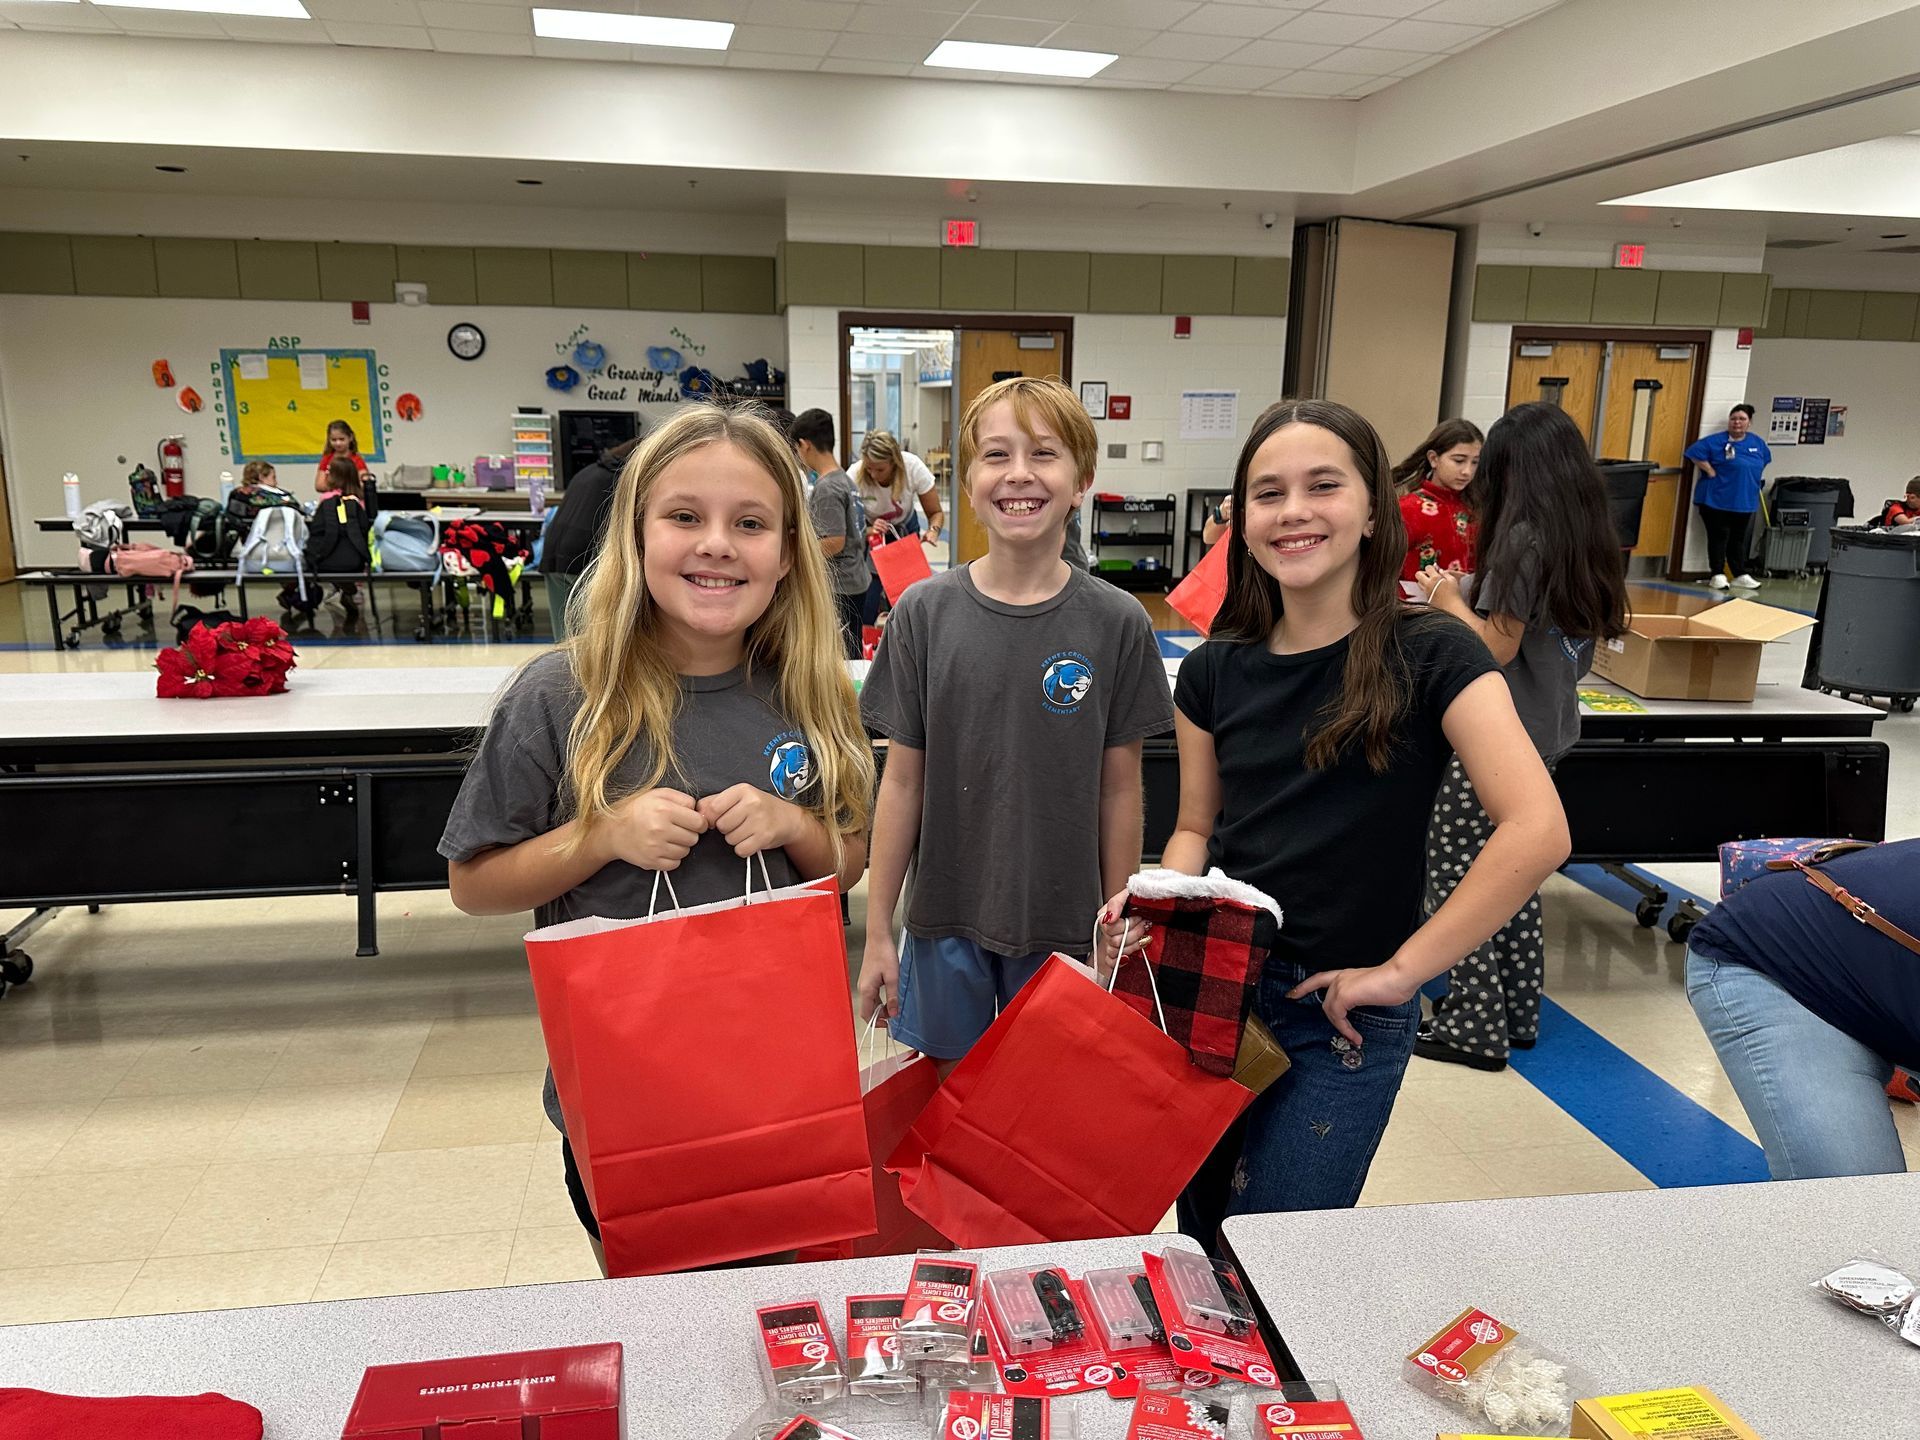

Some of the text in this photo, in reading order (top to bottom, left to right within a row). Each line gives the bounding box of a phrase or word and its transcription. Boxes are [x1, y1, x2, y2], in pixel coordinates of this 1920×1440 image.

[947, 220, 975, 246] EXIT
[1620, 245, 1645, 267] EXIT
[268, 336, 301, 349] ASP
[330, 355, 341, 368] 2
[607, 364, 663, 388] Growing
[587, 384, 679, 403] Great Minds
[210, 363, 229, 456] Parents
[240, 401, 249, 415] 3
[287, 399, 297, 412] 4
[350, 399, 360, 412] 5
[378, 364, 392, 447] Corner
[1067, 651, 1096, 673] CROSSING
[1041, 701, 1081, 715] ELEMENTARY
[763, 732, 787, 757] KEENE'S
[954, 1285, 968, 1299] 10
[807, 1323, 824, 1336] 10
[420, 1375, 556, 1396] MINI STRING LIGHTS
[991, 1403, 1000, 1429] LED LIGHTS
[1303, 1432, 1317, 1440] LED
[1318, 1432, 1343, 1440] LIGHTS
